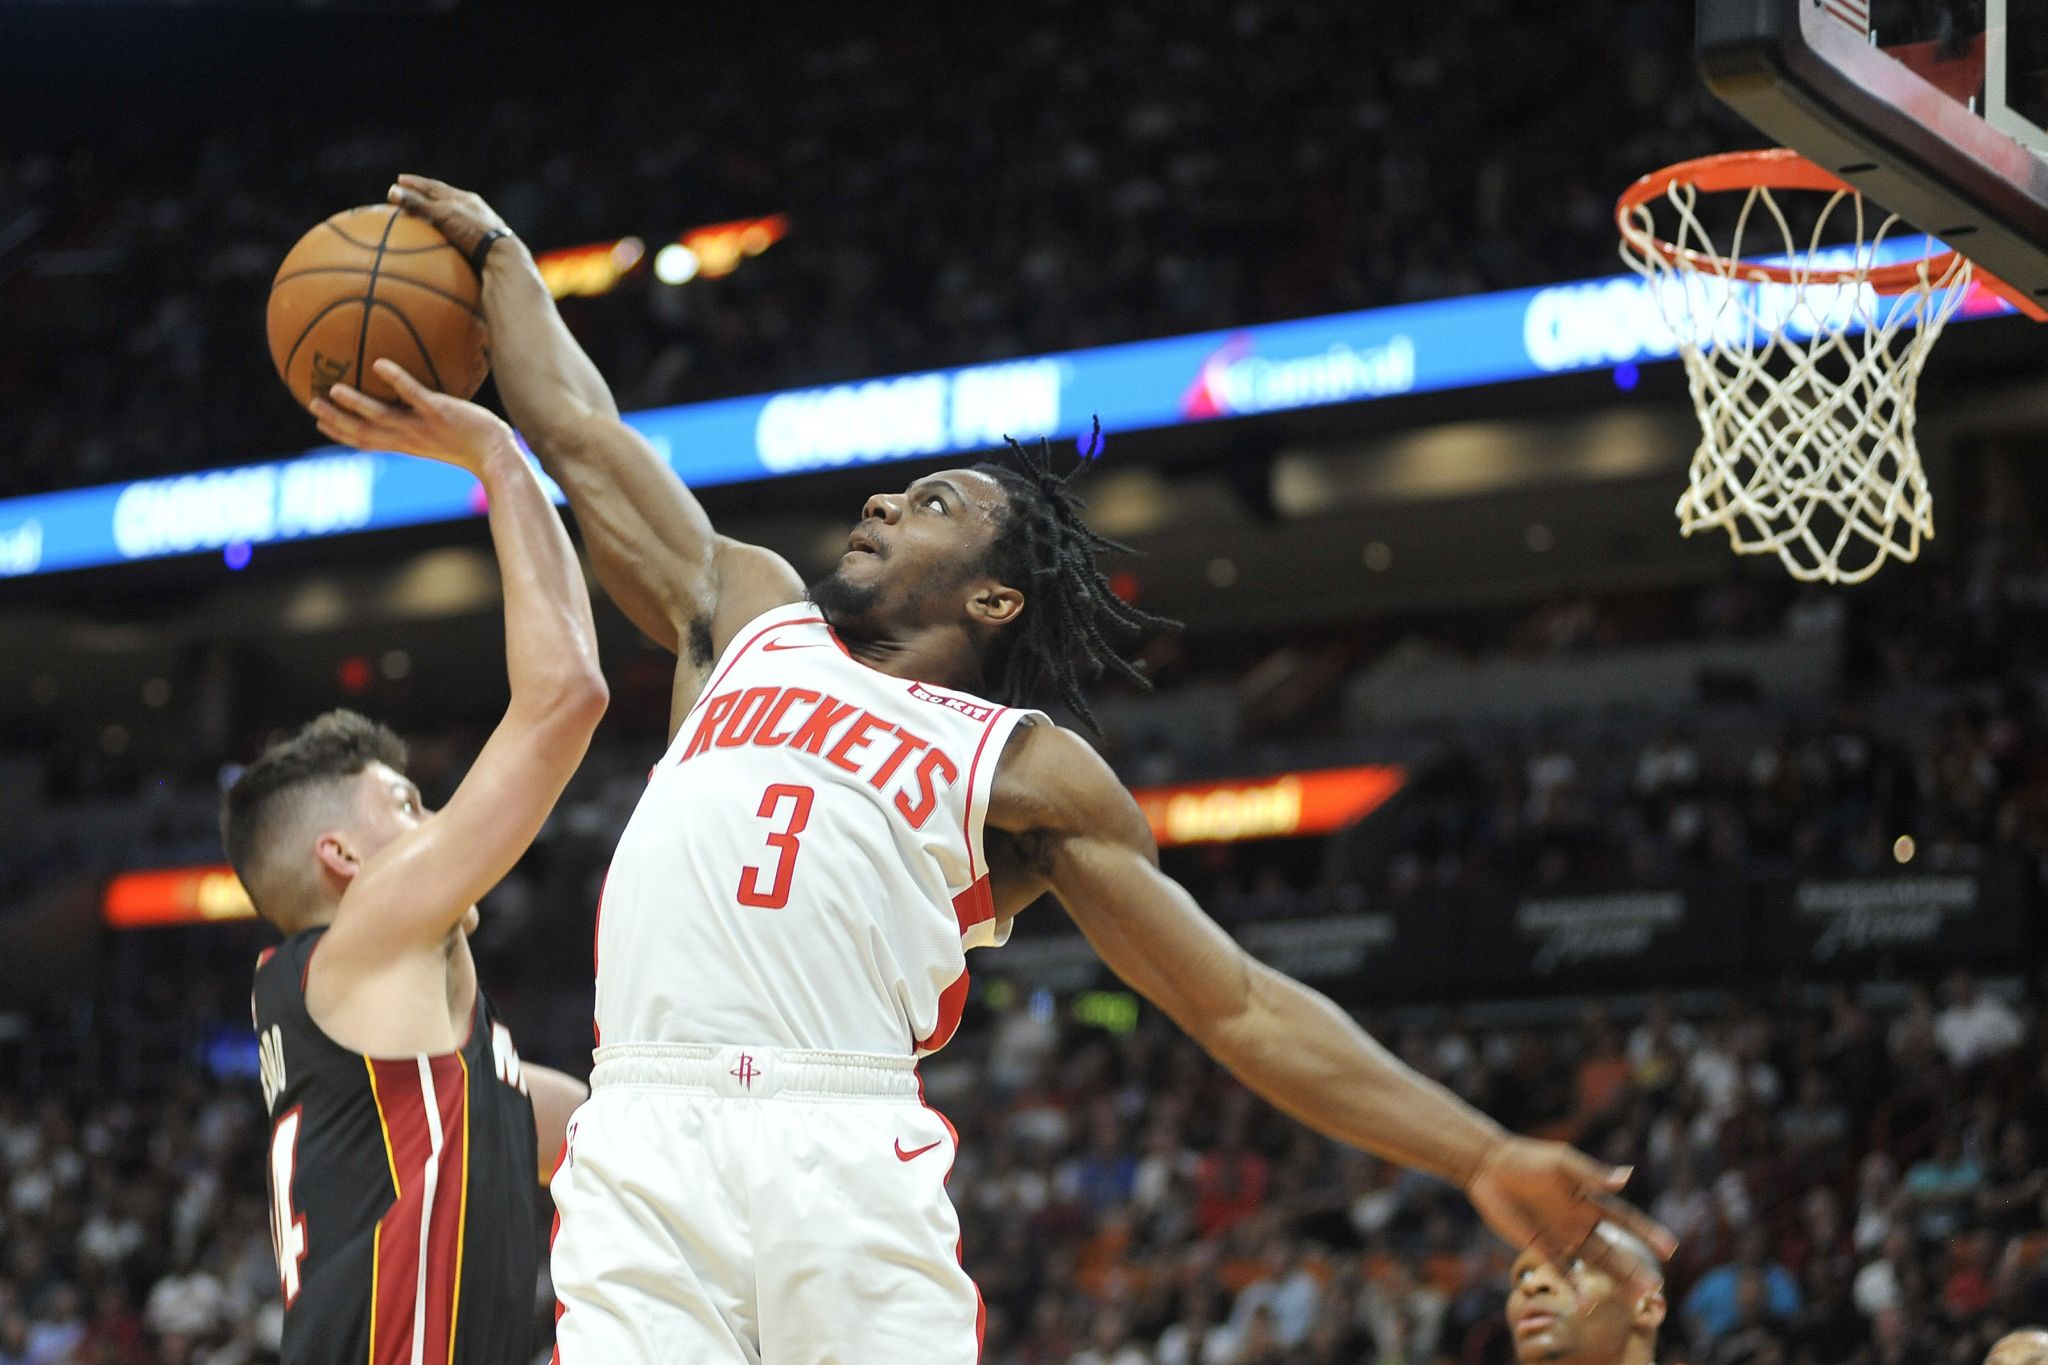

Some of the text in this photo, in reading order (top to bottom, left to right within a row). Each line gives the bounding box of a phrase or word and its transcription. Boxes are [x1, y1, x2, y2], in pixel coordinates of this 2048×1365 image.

[676, 686, 959, 831] ROCKETS
[736, 783, 815, 910] 3
[267, 1103, 309, 1312] 4
